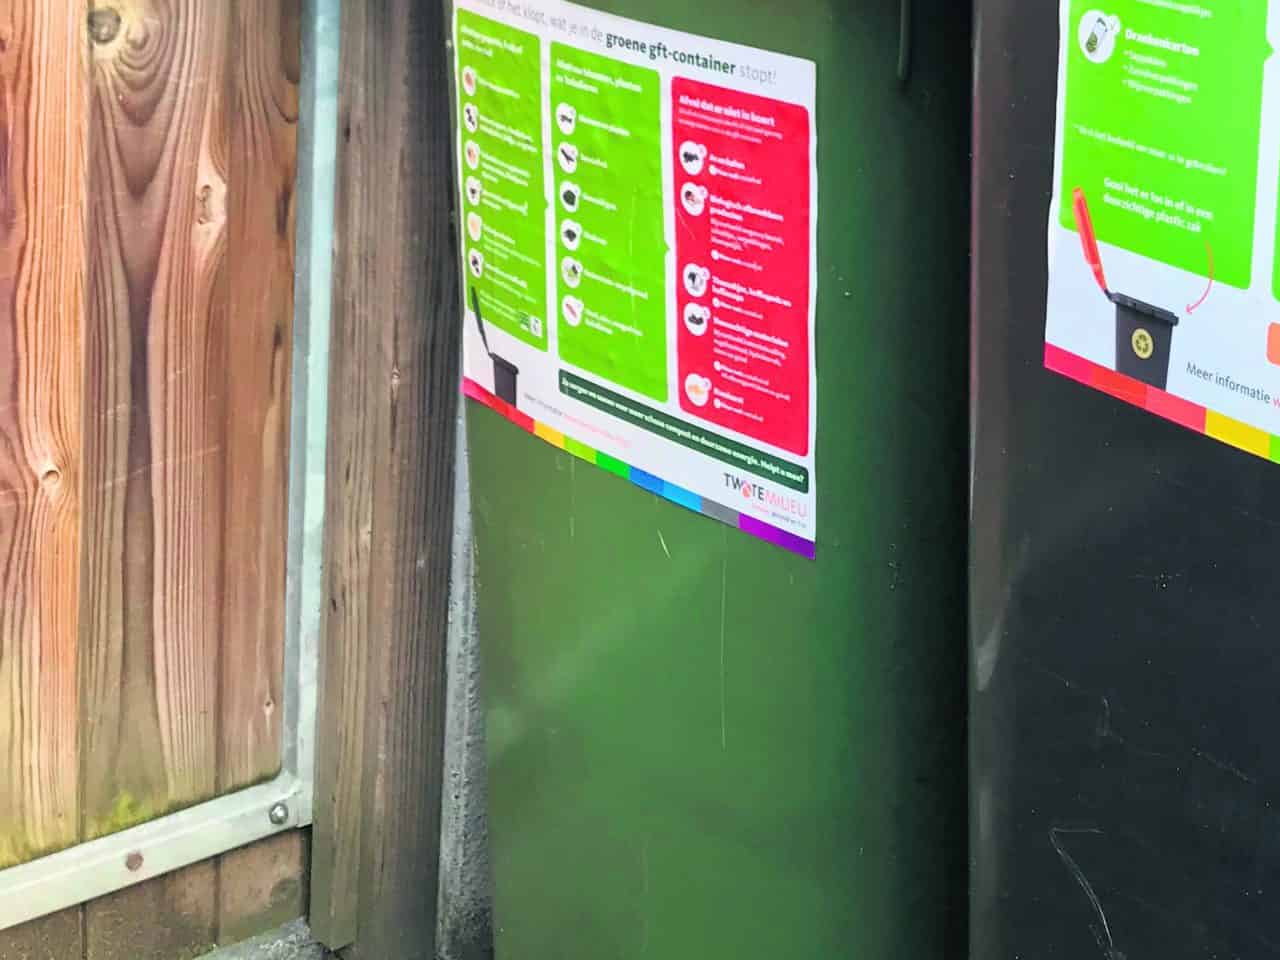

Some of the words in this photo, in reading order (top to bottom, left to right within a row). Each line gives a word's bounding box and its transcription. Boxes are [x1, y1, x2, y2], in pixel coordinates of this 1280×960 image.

[606, 32, 648, 54] groene
[649, 41, 737, 75] gft-container
[1186, 361, 1213, 382] Meer
[1215, 373, 1271, 404] informatie
